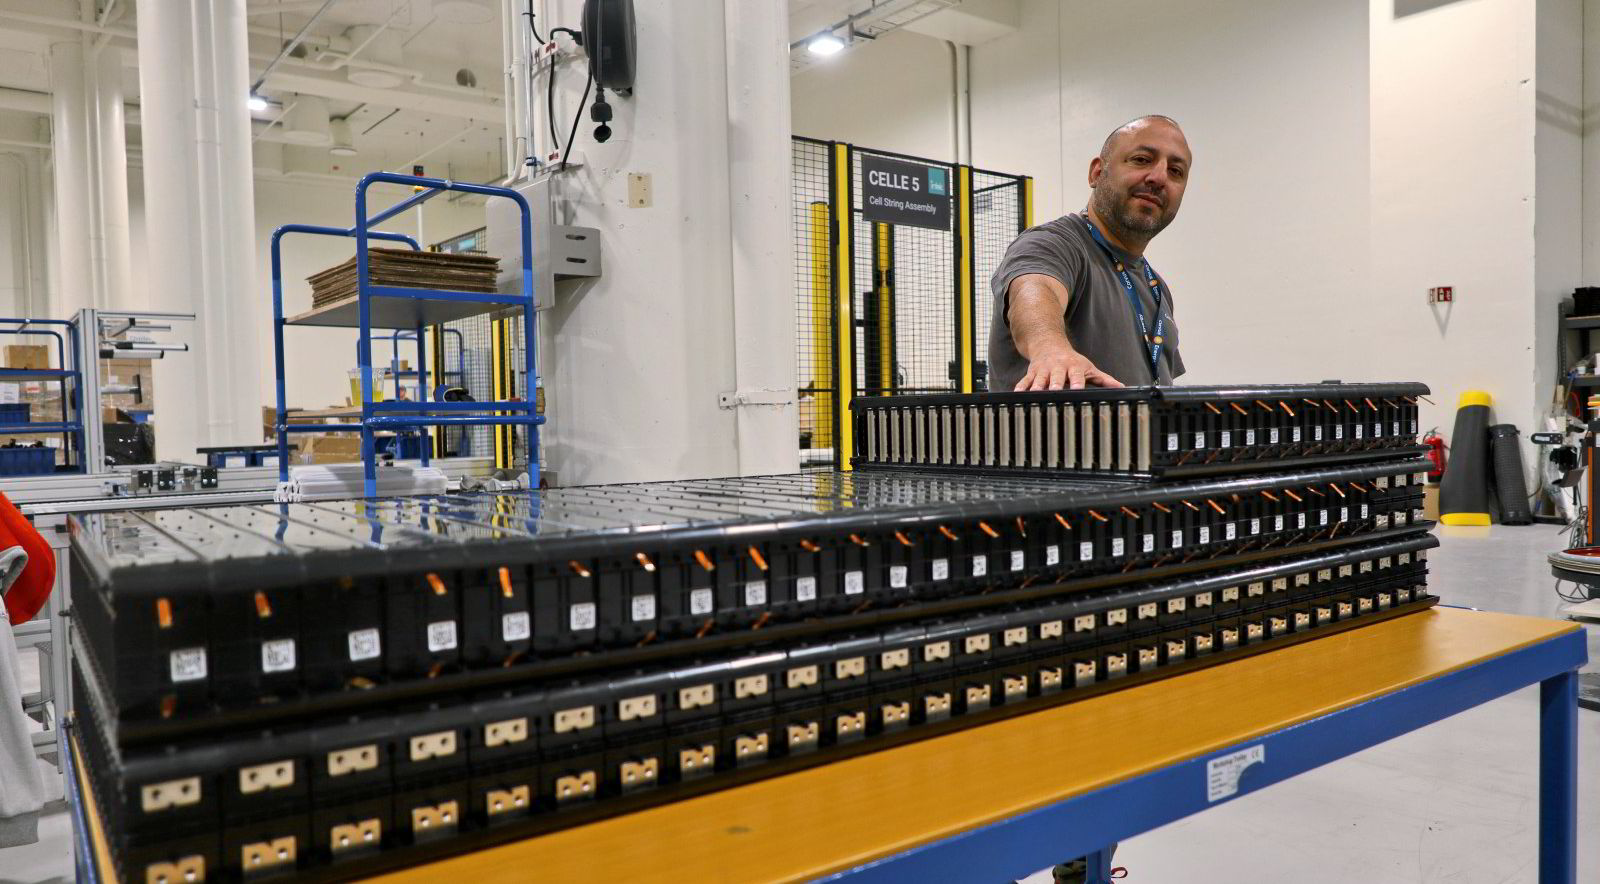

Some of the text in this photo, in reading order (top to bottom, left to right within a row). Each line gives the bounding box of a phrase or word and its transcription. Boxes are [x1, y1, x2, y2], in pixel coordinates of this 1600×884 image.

[869, 170, 920, 192] CELLE 5
[869, 195, 937, 215] Cell String Assembly
